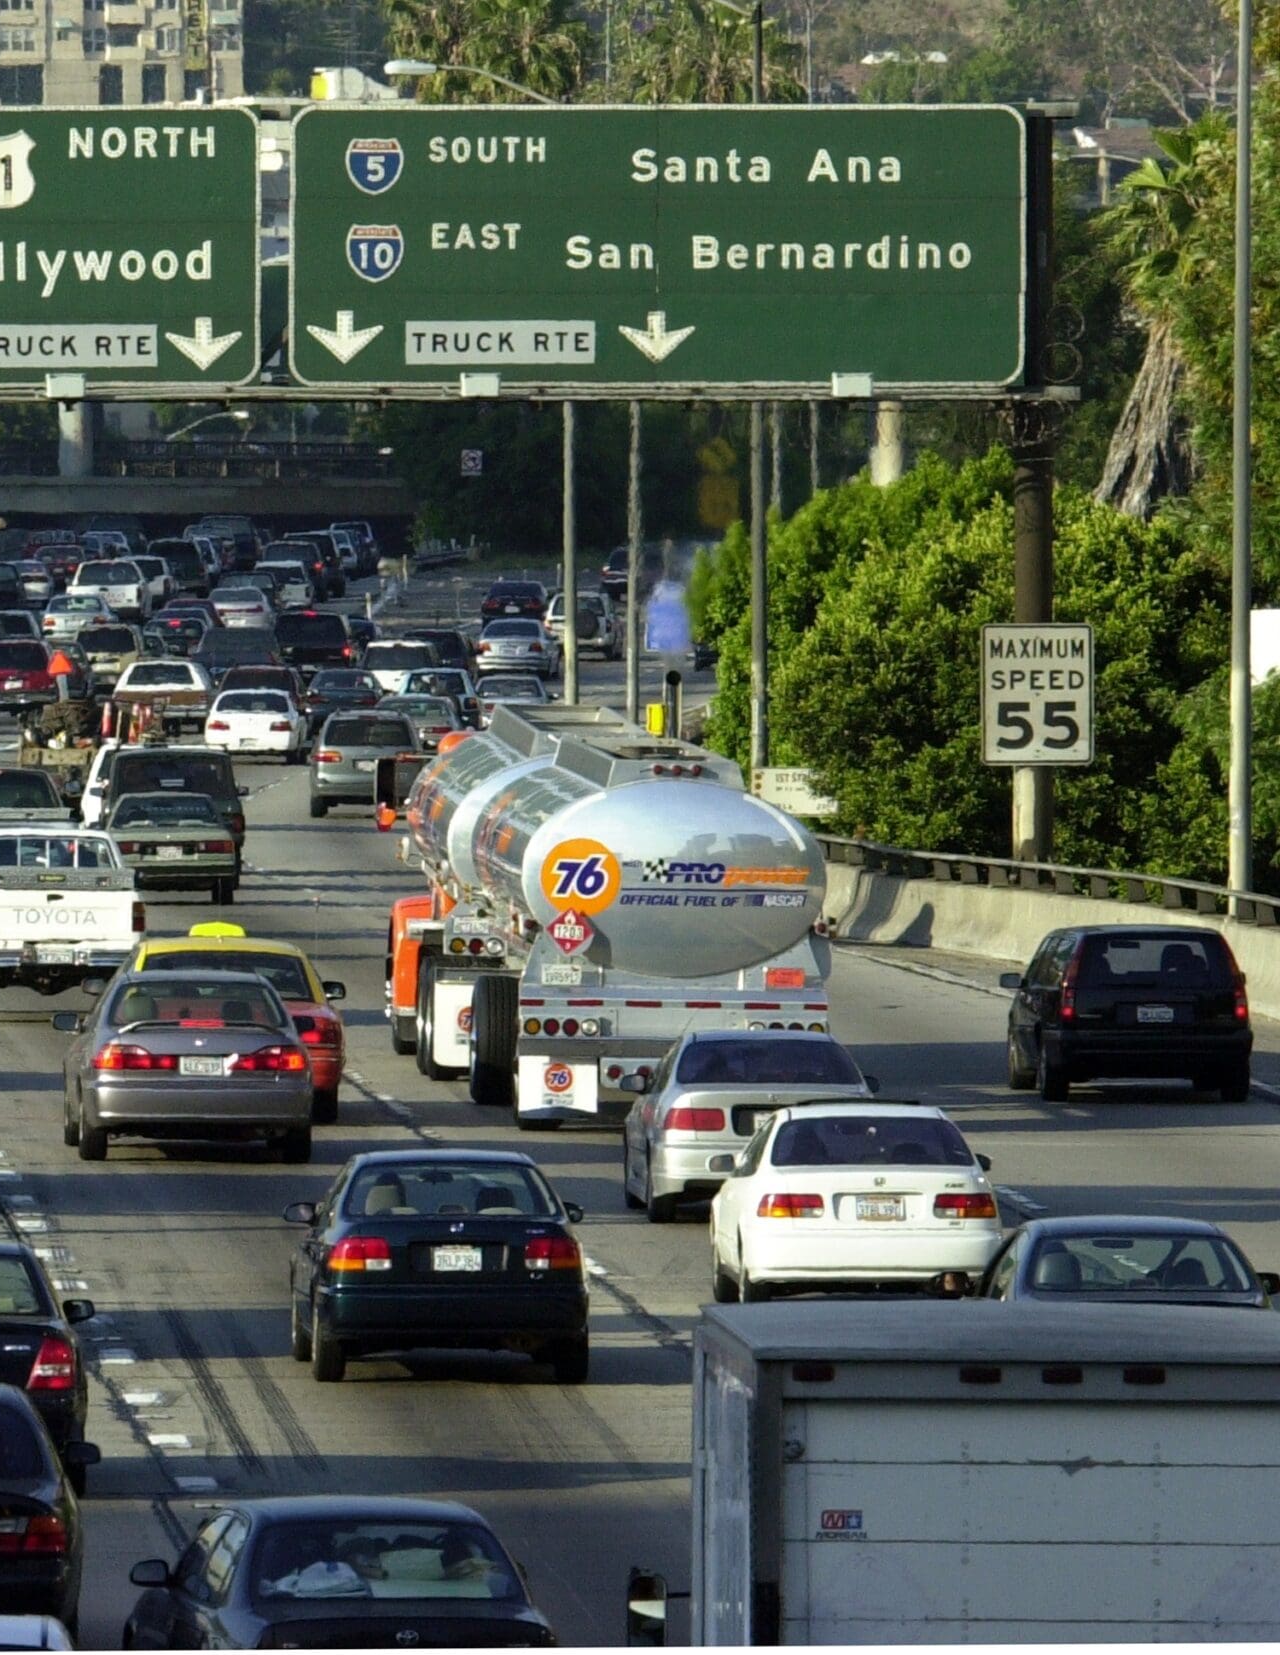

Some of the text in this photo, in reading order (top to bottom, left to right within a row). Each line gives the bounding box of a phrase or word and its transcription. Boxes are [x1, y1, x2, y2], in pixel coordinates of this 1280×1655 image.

[69, 127, 215, 158] NORTH
[429, 137, 545, 163] SOUTH
[367, 156, 385, 182] 5
[632, 148, 900, 182] Santa Ana
[432, 223, 521, 249] EAST
[358, 242, 394, 269] 10
[566, 236, 971, 269] San Bernardino
[95, 336, 151, 356] RTE
[412, 332, 589, 353] TRUCK RTE
[990, 637, 1084, 658] MAXIMUM
[992, 670, 1084, 690] SPEED
[997, 701, 1079, 749] 55
[552, 854, 608, 898] 76
[620, 894, 805, 907] OFFICIAL FUEL OF NASCAR
[12, 908, 97, 924] TOYOTA
[556, 925, 583, 939] 1203
[547, 1070, 570, 1087] 76
